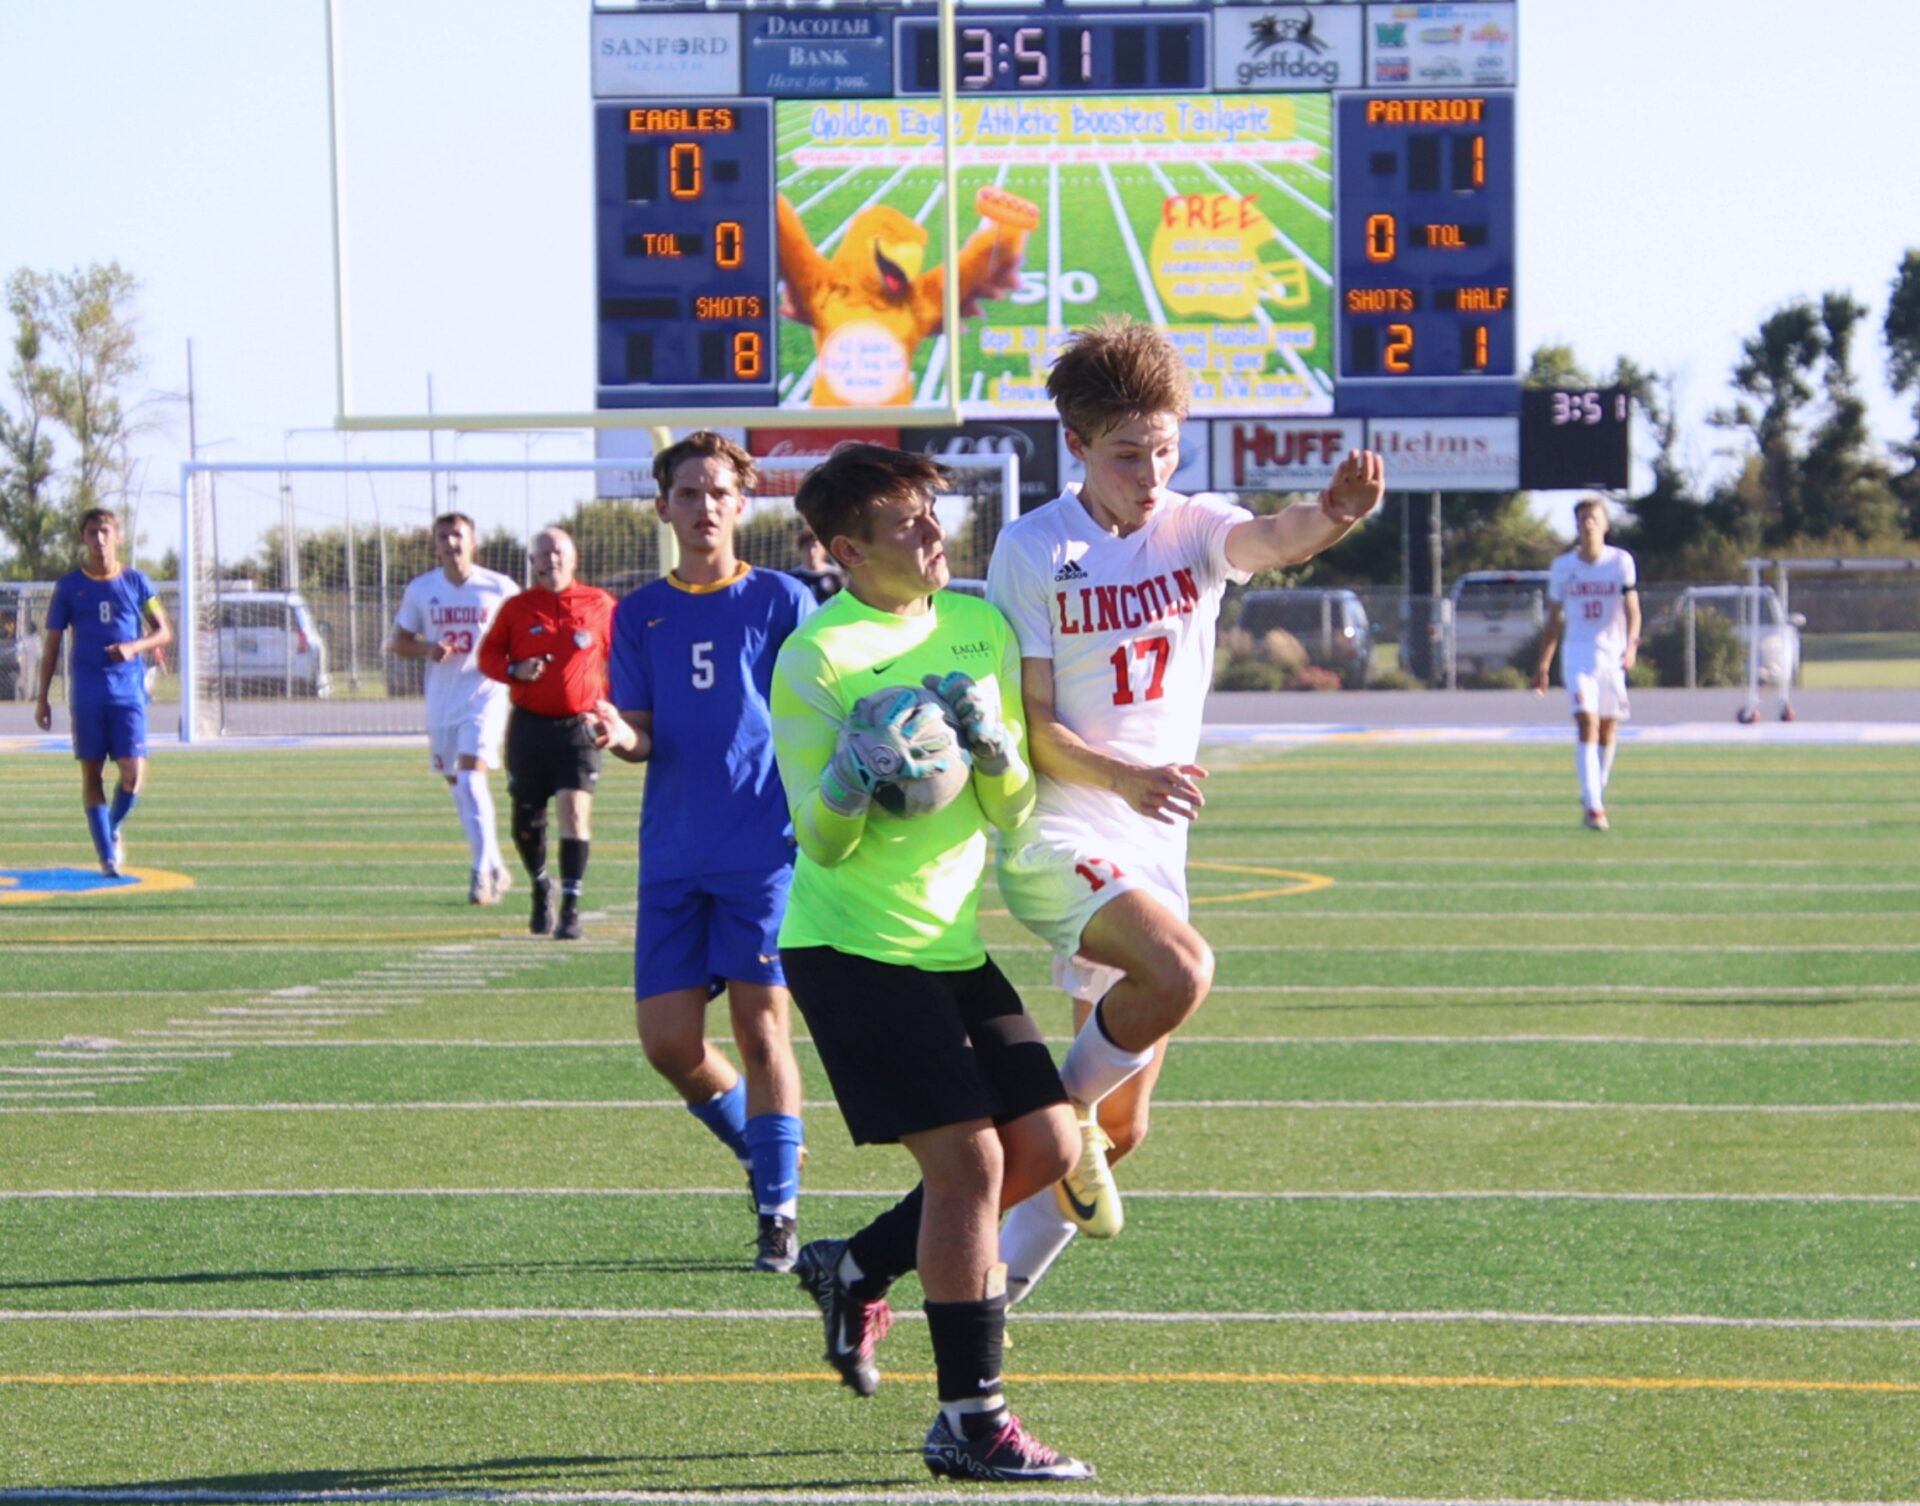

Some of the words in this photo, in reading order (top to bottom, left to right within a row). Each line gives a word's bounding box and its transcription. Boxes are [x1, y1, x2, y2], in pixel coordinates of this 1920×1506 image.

[768, 16, 870, 35] DACOTAH
[601, 37, 728, 56] SANFORD
[789, 47, 848, 67] BANK
[962, 27, 1092, 87] 3:51
[767, 73, 803, 88] Here
[806, 72, 830, 90] for
[1237, 50, 1340, 84] geffdog
[628, 108, 733, 132] EAGLES
[811, 100, 888, 140] Golden
[899, 107, 961, 147] Eage
[977, 100, 1060, 135] Athletic
[1072, 103, 1165, 135] Boosters
[1176, 97, 1269, 143] Tailgate
[1367, 99, 1484, 123] PATRIOT
[669, 142, 703, 198] 0
[1472, 136, 1486, 187] 1
[1163, 193, 1263, 230] FREE
[642, 233, 683, 256] TOL
[715, 221, 743, 268] 0
[1366, 213, 1396, 261] 0
[1425, 224, 1466, 247] TOL
[1012, 270, 1098, 303] 50
[1348, 288, 1414, 312] SHOTS
[1456, 288, 1508, 310] HALF
[695, 297, 761, 319] SHOTS
[733, 331, 762, 379] 8
[1384, 324, 1414, 372] 2
[1475, 326, 1488, 369] 1
[1552, 392, 1626, 425] 3:51
[1233, 422, 1344, 487] HUFF
[1374, 430, 1489, 453] Helms
[1055, 571, 1088, 582] adidas
[99, 601, 111, 623] 8
[1057, 567, 1199, 634] LINCOLN
[1583, 601, 1603, 619] 10
[692, 641, 715, 690] 5
[1110, 636, 1170, 705] 17
